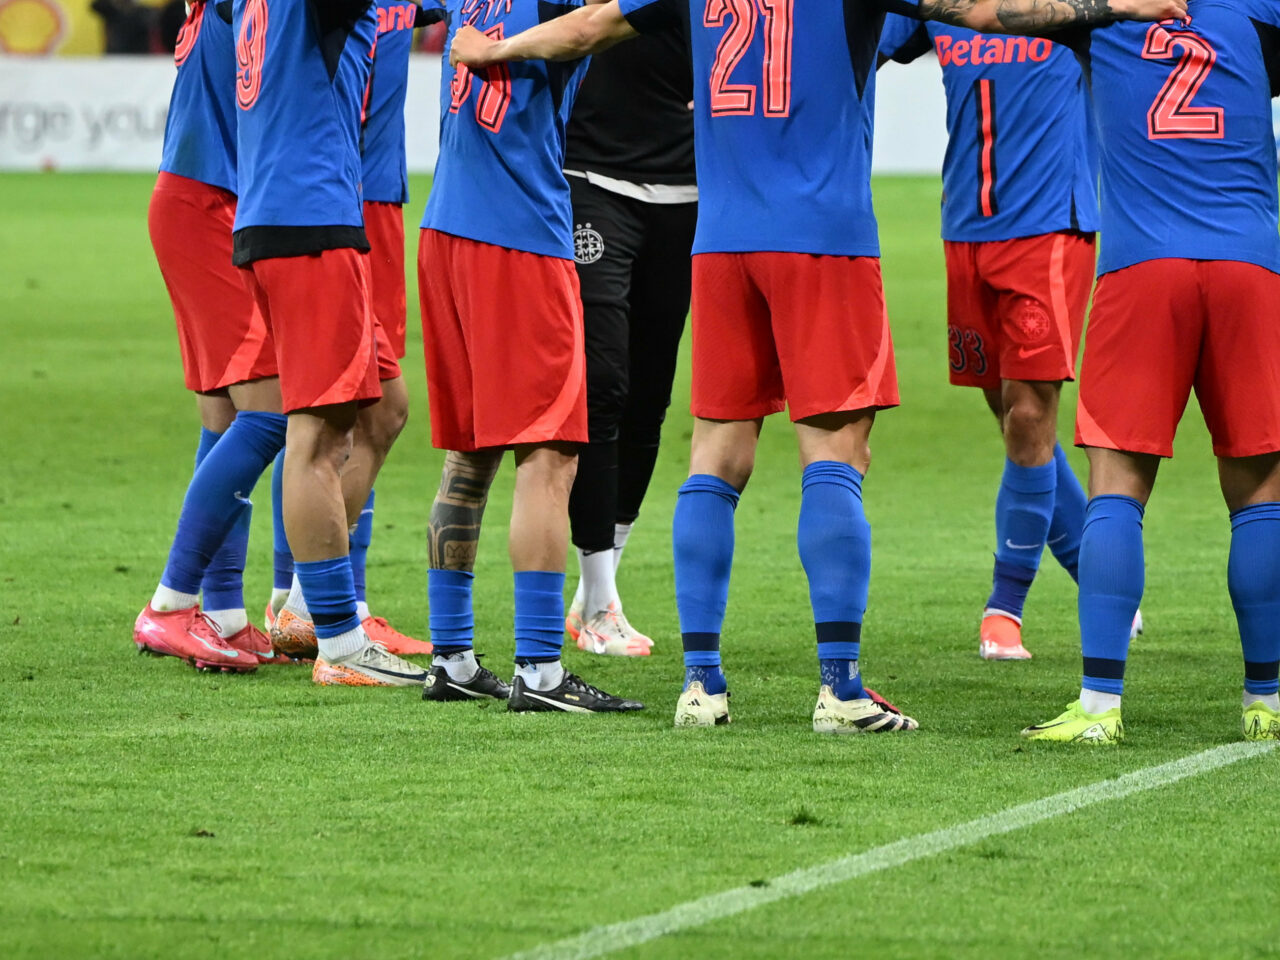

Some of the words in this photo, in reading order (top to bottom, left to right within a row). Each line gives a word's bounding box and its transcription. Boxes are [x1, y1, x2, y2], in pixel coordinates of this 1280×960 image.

[934, 34, 1053, 67] Betano
[1141, 23, 1225, 141] 2
[947, 325, 988, 376] 33
